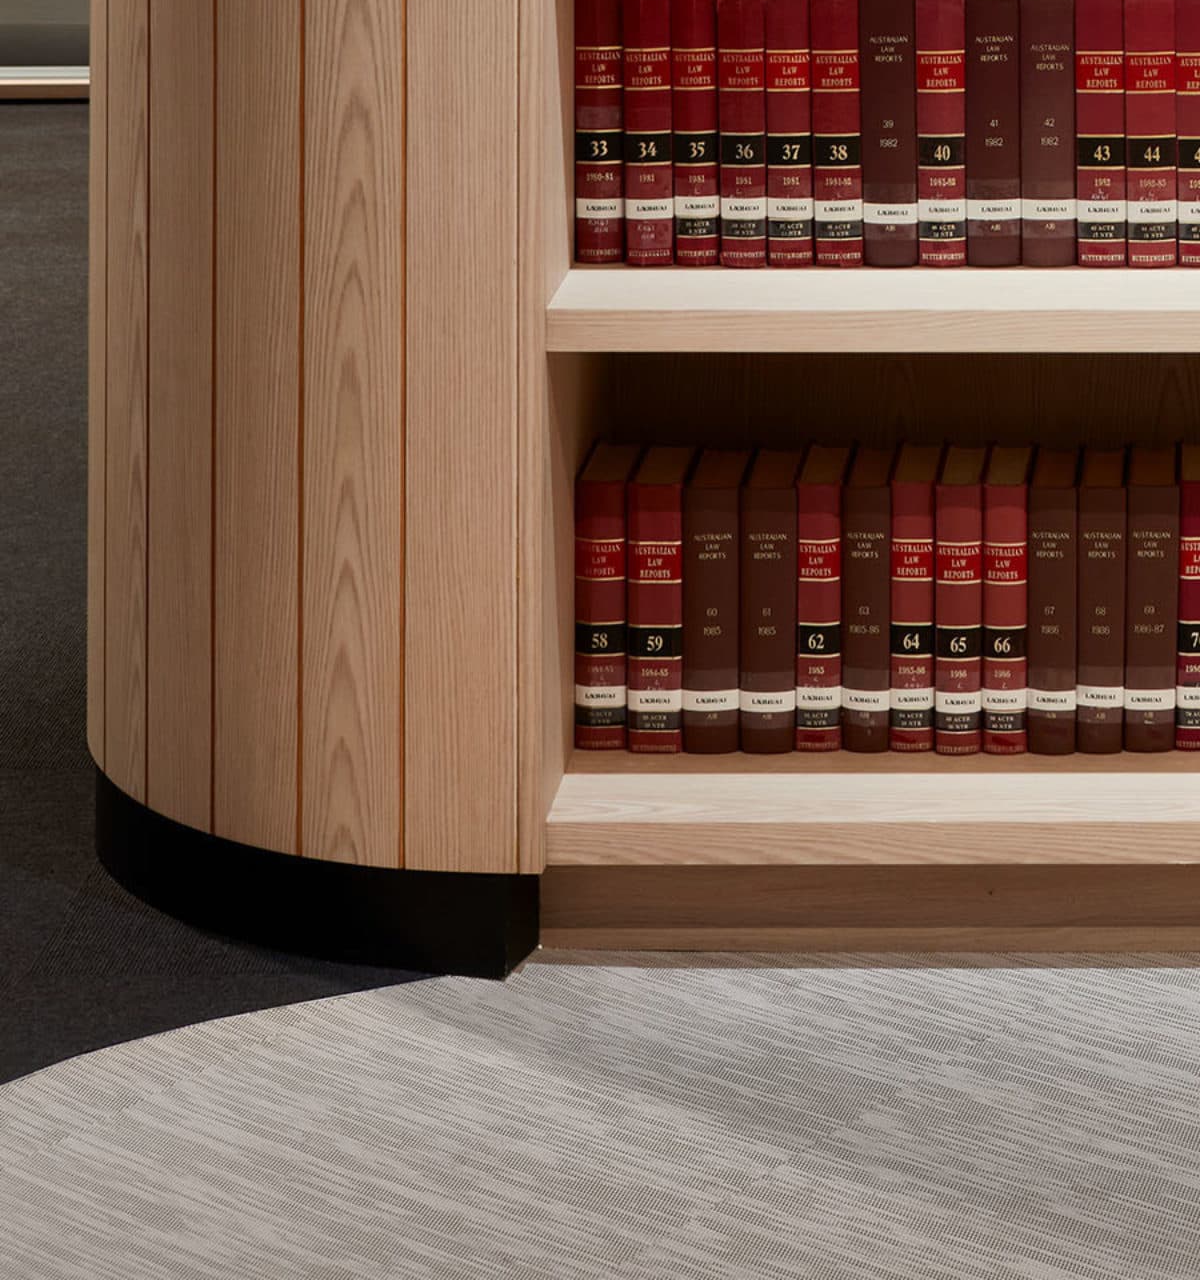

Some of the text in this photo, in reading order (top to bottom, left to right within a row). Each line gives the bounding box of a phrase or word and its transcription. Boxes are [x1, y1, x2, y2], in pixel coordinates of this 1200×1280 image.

[590, 139, 609, 157] 33
[638, 140, 658, 159] 34
[689, 140, 706, 159] 35
[735, 142, 755, 160] 36
[782, 143, 802, 161] 37
[828, 143, 849, 162] 38
[933, 144, 952, 162] 40
[1092, 144, 1112, 162] 43
[1142, 145, 1162, 163] 44
[591, 632, 609, 650] 58
[646, 634, 665, 652] 59
[807, 632, 826, 651] 62
[902, 632, 921, 651] 64
[949, 635, 968, 654] 65
[992, 636, 1012, 654] 66
